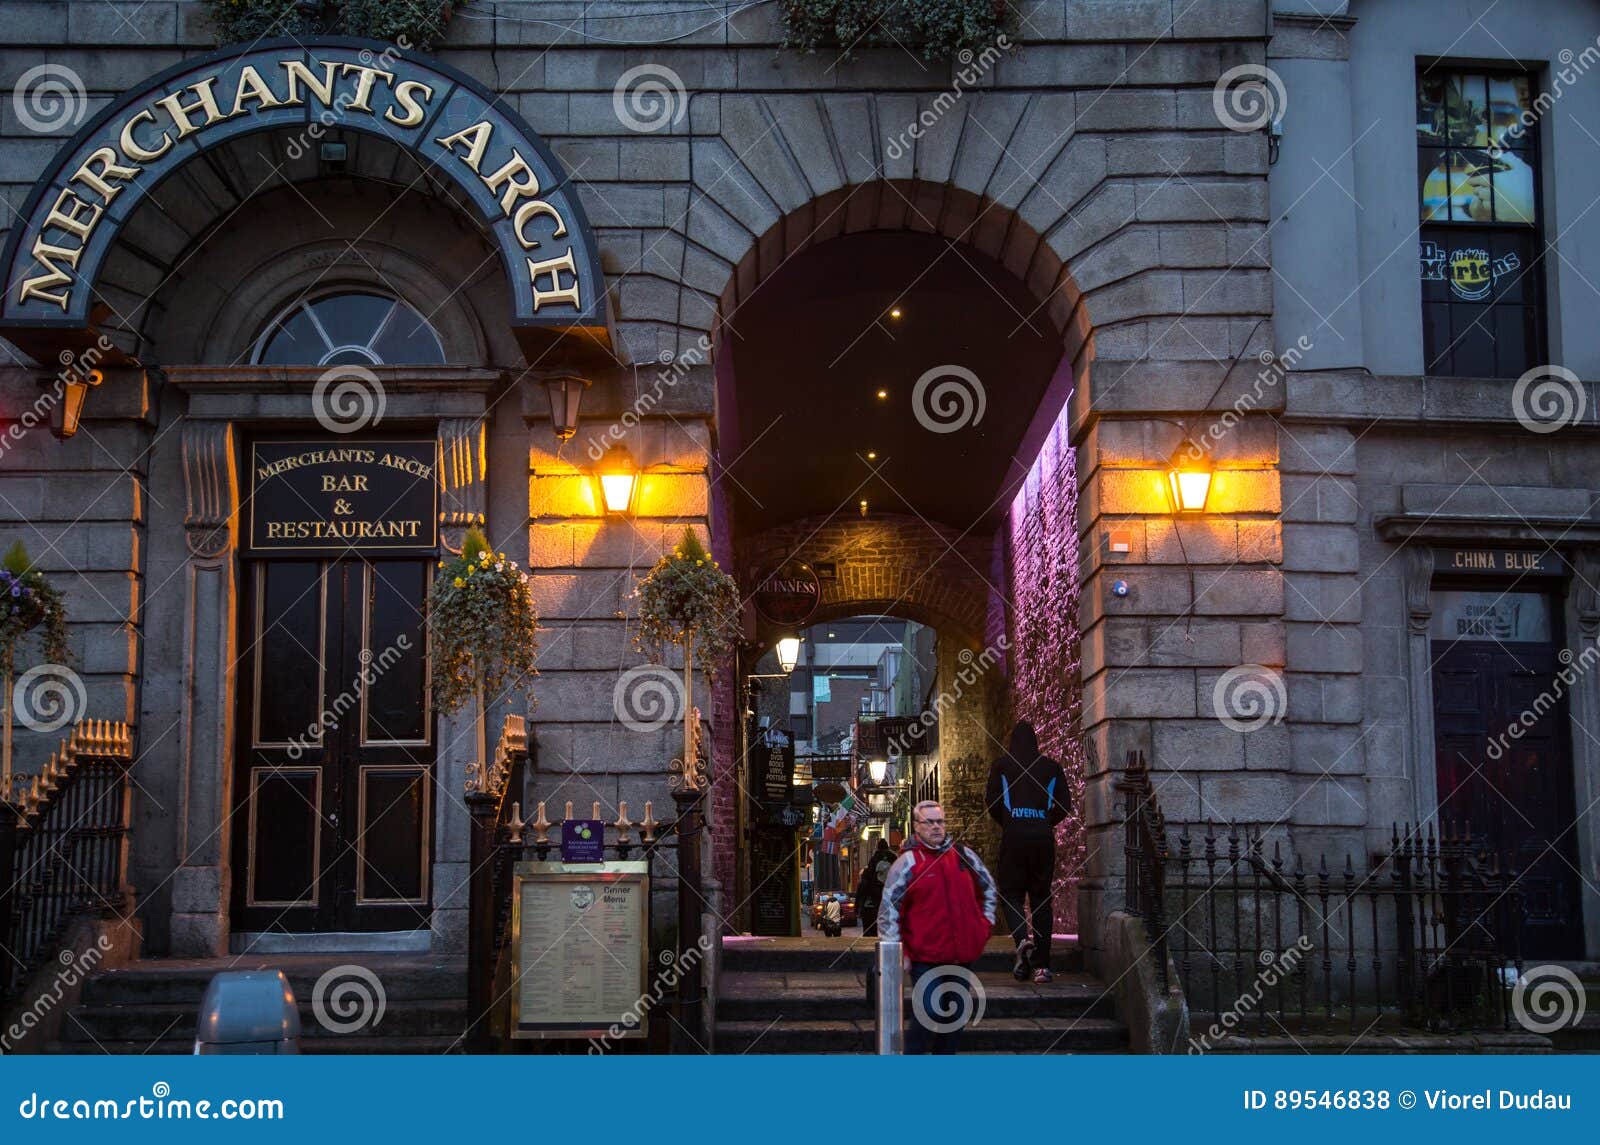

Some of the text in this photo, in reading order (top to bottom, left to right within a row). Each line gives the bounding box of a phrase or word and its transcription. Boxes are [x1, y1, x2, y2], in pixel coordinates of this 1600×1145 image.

[19, 60, 581, 313] MERCHANTS ARCH
[257, 449, 433, 481] MERCHANTS ARCH
[321, 474, 369, 492] BAR
[333, 498, 355, 515] &
[266, 520, 421, 538] RESTAURANT
